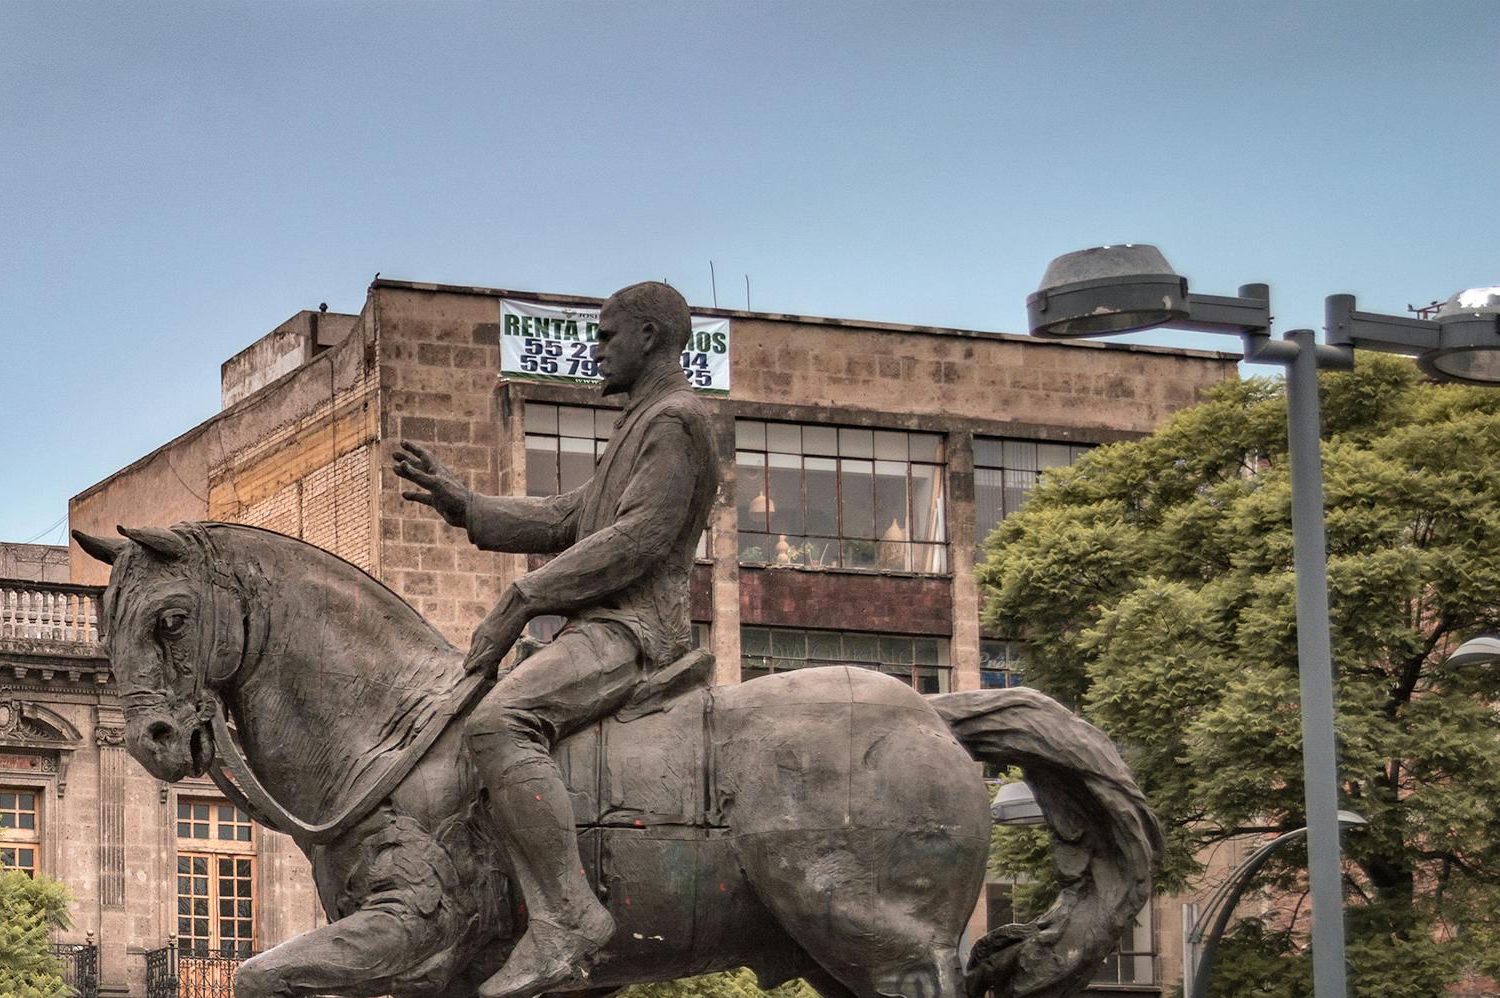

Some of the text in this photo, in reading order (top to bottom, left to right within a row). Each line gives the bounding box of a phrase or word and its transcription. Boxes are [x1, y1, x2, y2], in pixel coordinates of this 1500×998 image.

[504, 313, 580, 342] RENTA
[524, 338, 563, 357] 55
[520, 354, 559, 374] 55
